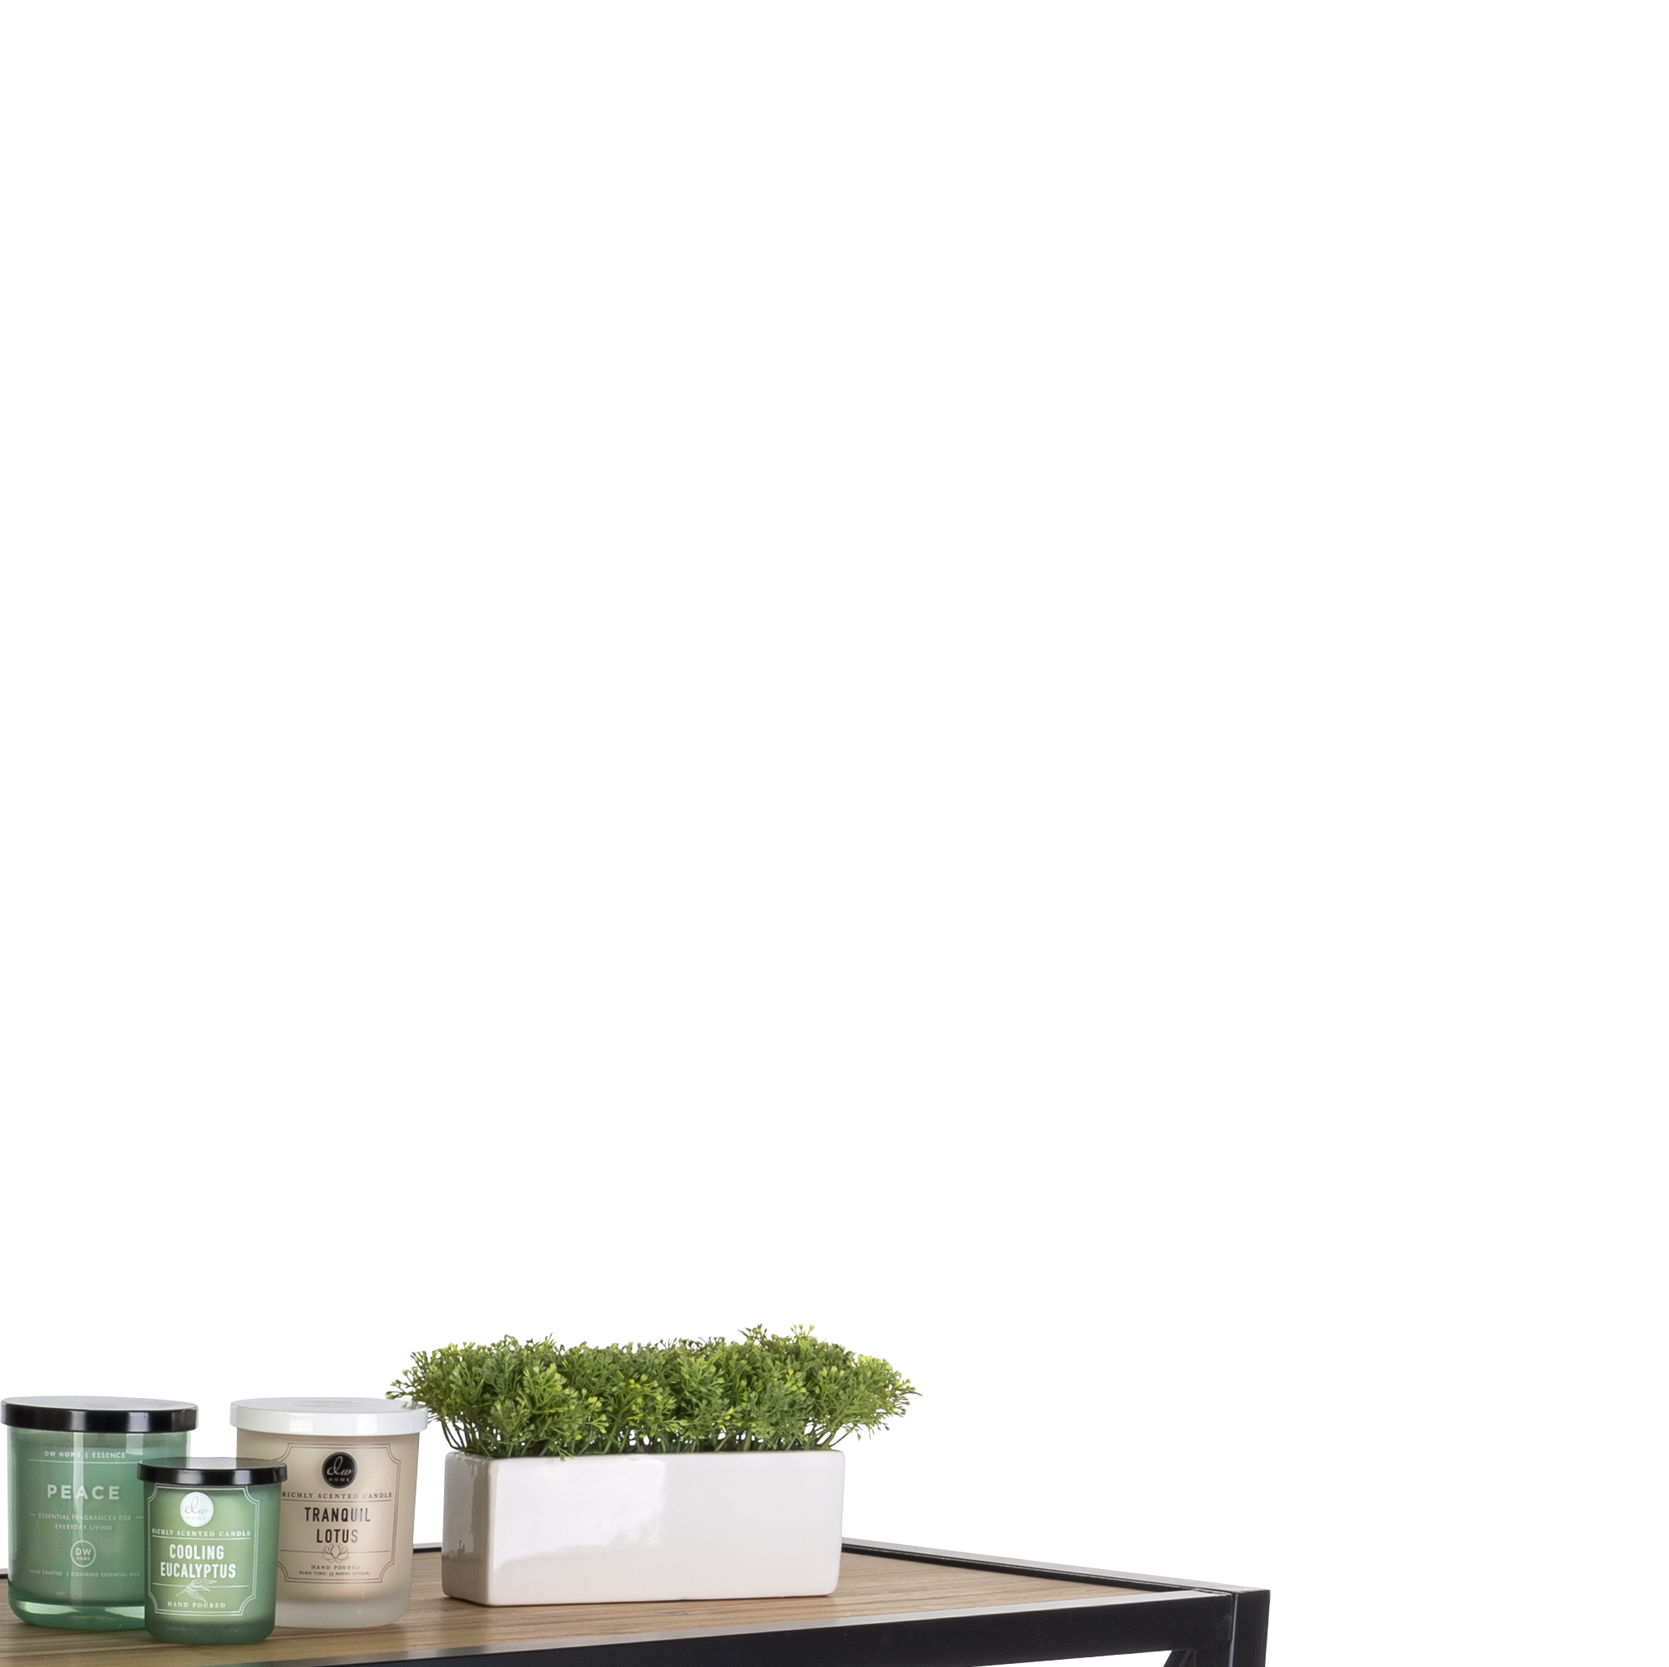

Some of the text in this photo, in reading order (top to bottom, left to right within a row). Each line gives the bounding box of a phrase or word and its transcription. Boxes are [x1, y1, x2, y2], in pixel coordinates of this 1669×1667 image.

[47, 1484, 120, 1500] PEACE
[304, 1507, 371, 1522] TRANQUIL
[316, 1528, 358, 1543] LOTUS
[75, 1547, 92, 1556] DW
[169, 1544, 224, 1560] COOLING
[160, 1561, 236, 1579] EUCALYPTUS
